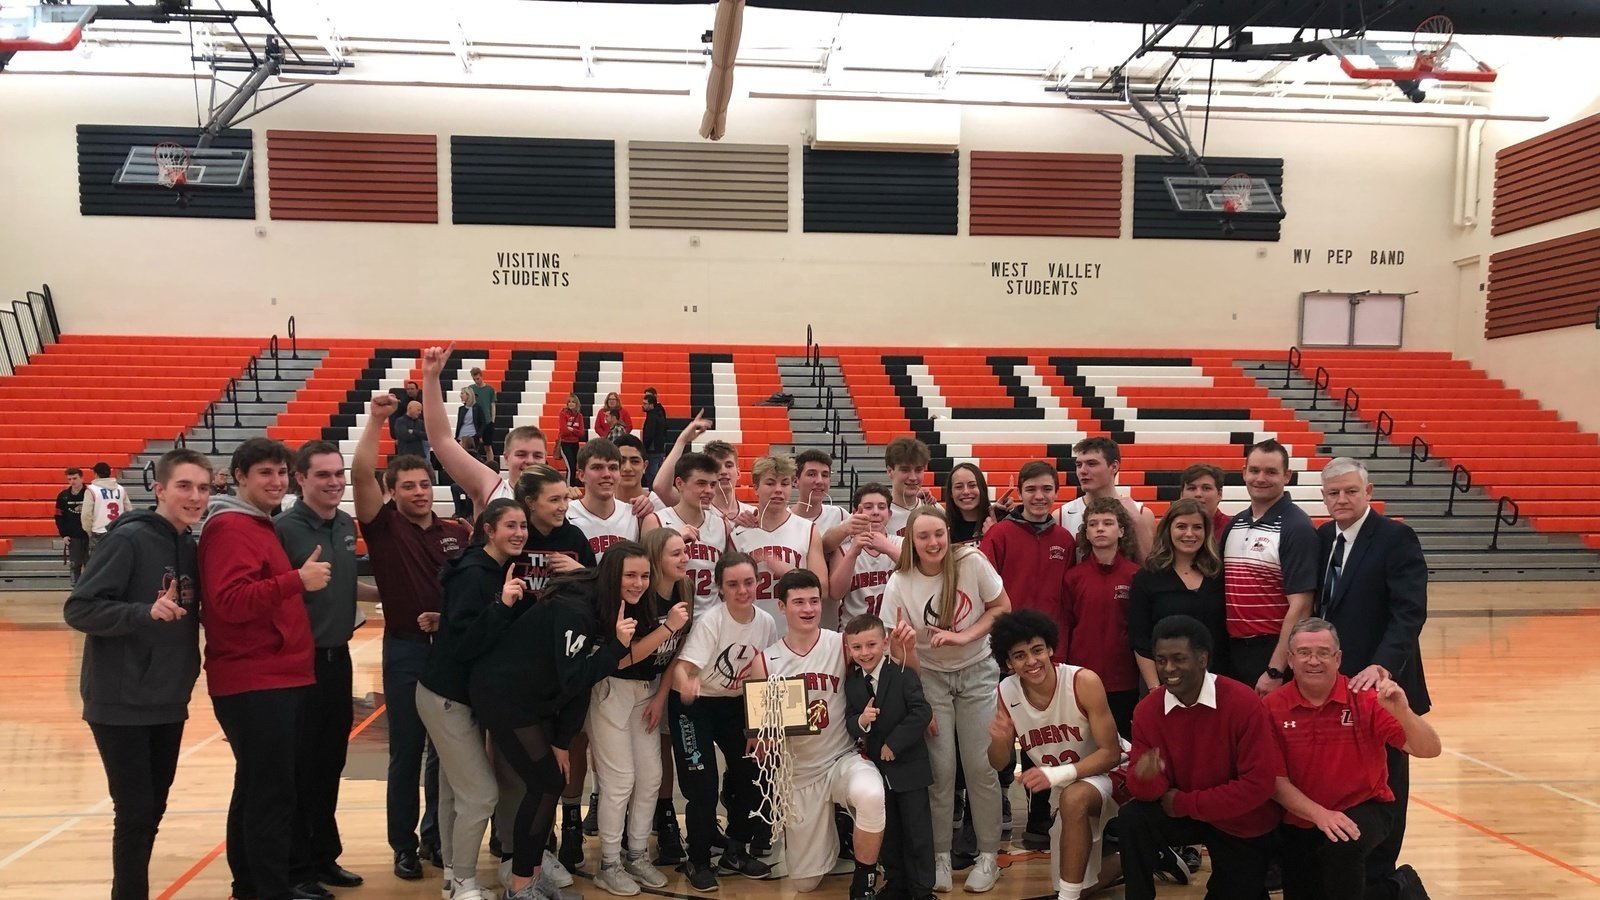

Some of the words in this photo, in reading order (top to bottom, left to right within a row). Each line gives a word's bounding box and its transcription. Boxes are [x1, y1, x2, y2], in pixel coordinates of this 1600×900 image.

[497, 252, 560, 269] VISITING
[1293, 248, 1311, 264] WV
[1327, 249, 1353, 265] PEP
[1370, 249, 1405, 265] BAND
[492, 269, 570, 287] STUDENTS
[991, 261, 1029, 277] WEST
[1048, 262, 1101, 279] VALLEY
[1006, 279, 1078, 296] STUDENTS
[106, 502, 120, 520] 3
[564, 629, 587, 659] 14
[1019, 723, 1084, 752] LIBERTY
